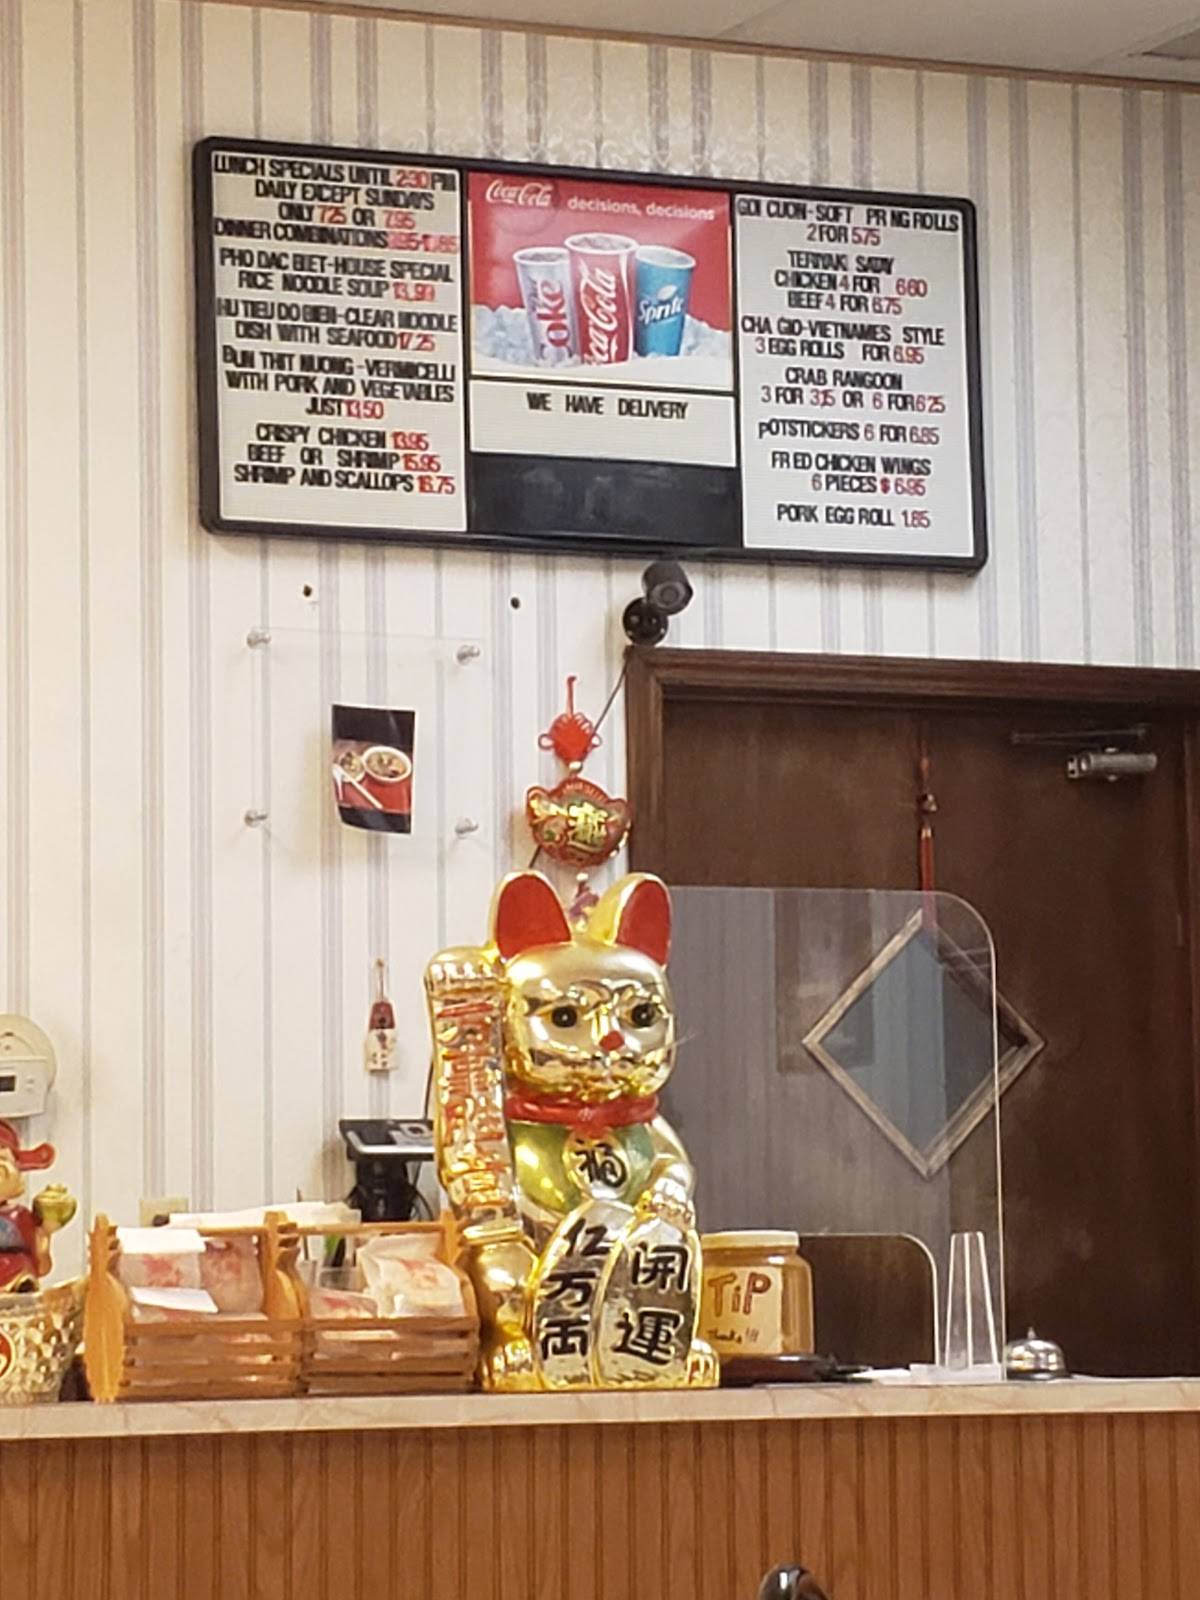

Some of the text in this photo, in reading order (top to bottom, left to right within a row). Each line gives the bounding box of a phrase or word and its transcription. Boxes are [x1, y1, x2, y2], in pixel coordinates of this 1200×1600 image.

[214, 154, 265, 175] LUNCH
[269, 159, 345, 182] SPECIALS
[351, 166, 393, 187] UNTIL
[255, 180, 434, 211] DAILY EXCEPT SUNDAYS
[567, 195, 715, 221] decisions, decisions
[279, 203, 315, 221] ONLY
[352, 208, 376, 227] OR
[913, 212, 959, 232] ROLLS
[214, 218, 271, 240] DINNER
[274, 223, 388, 249] COMBINATIONS
[807, 223, 817, 242] 2
[819, 225, 848, 244] FOR
[219, 247, 254, 268] PHO
[257, 250, 289, 270] DAC
[390, 261, 453, 283] SPECIAL
[238, 270, 274, 290] RICE
[282, 273, 343, 296] NOODLE
[347, 278, 390, 298] SOUP
[775, 270, 837, 291] CHICKEN
[839, 275, 849, 291] 4
[852, 275, 880, 294] FOR
[638, 295, 684, 325] Sprite
[787, 291, 824, 310] BEEF
[825, 293, 836, 311] 4
[840, 294, 869, 312] FOR
[278, 302, 301, 321] DO
[398, 311, 457, 333] NOODLE
[741, 315, 772, 334] CHA
[903, 326, 945, 347] STYLE
[235, 321, 271, 341] DISH
[277, 323, 320, 344] WITH
[327, 326, 397, 349] SEAFOOD
[260, 351, 296, 371] THIT
[755, 336, 766, 354] 3
[768, 337, 797, 356] EGG
[800, 340, 845, 360] ROLLS
[862, 343, 890, 362] FOR
[225, 370, 455, 403] WITH PORK AND VEGETABLES
[785, 367, 902, 390] CRAB RANGOON
[305, 398, 343, 418] JUST
[526, 392, 688, 420] WE HAVE DELIVERY
[761, 385, 771, 403] 3
[775, 386, 804, 405] FOR
[842, 390, 864, 409] OR
[872, 391, 883, 410] 6
[887, 393, 915, 412] FOR
[255, 422, 311, 444] CRISPY
[318, 427, 386, 450] CHICKEN
[863, 424, 875, 442] 6
[880, 424, 907, 443] FOR
[247, 443, 285, 464] BEEF
[300, 447, 323, 466] OR
[337, 449, 400, 470] SHRIMP
[815, 453, 876, 475] CHICKEN
[880, 456, 932, 477] WINGS
[234, 464, 295, 485] SHRIMP
[300, 468, 332, 488] AND
[335, 471, 414, 494] SCALLOPS
[811, 473, 822, 492] 6
[825, 474, 877, 494] PIECES
[777, 503, 819, 524] PORK
[825, 506, 855, 526] EGG
[858, 508, 895, 527] ROLL
